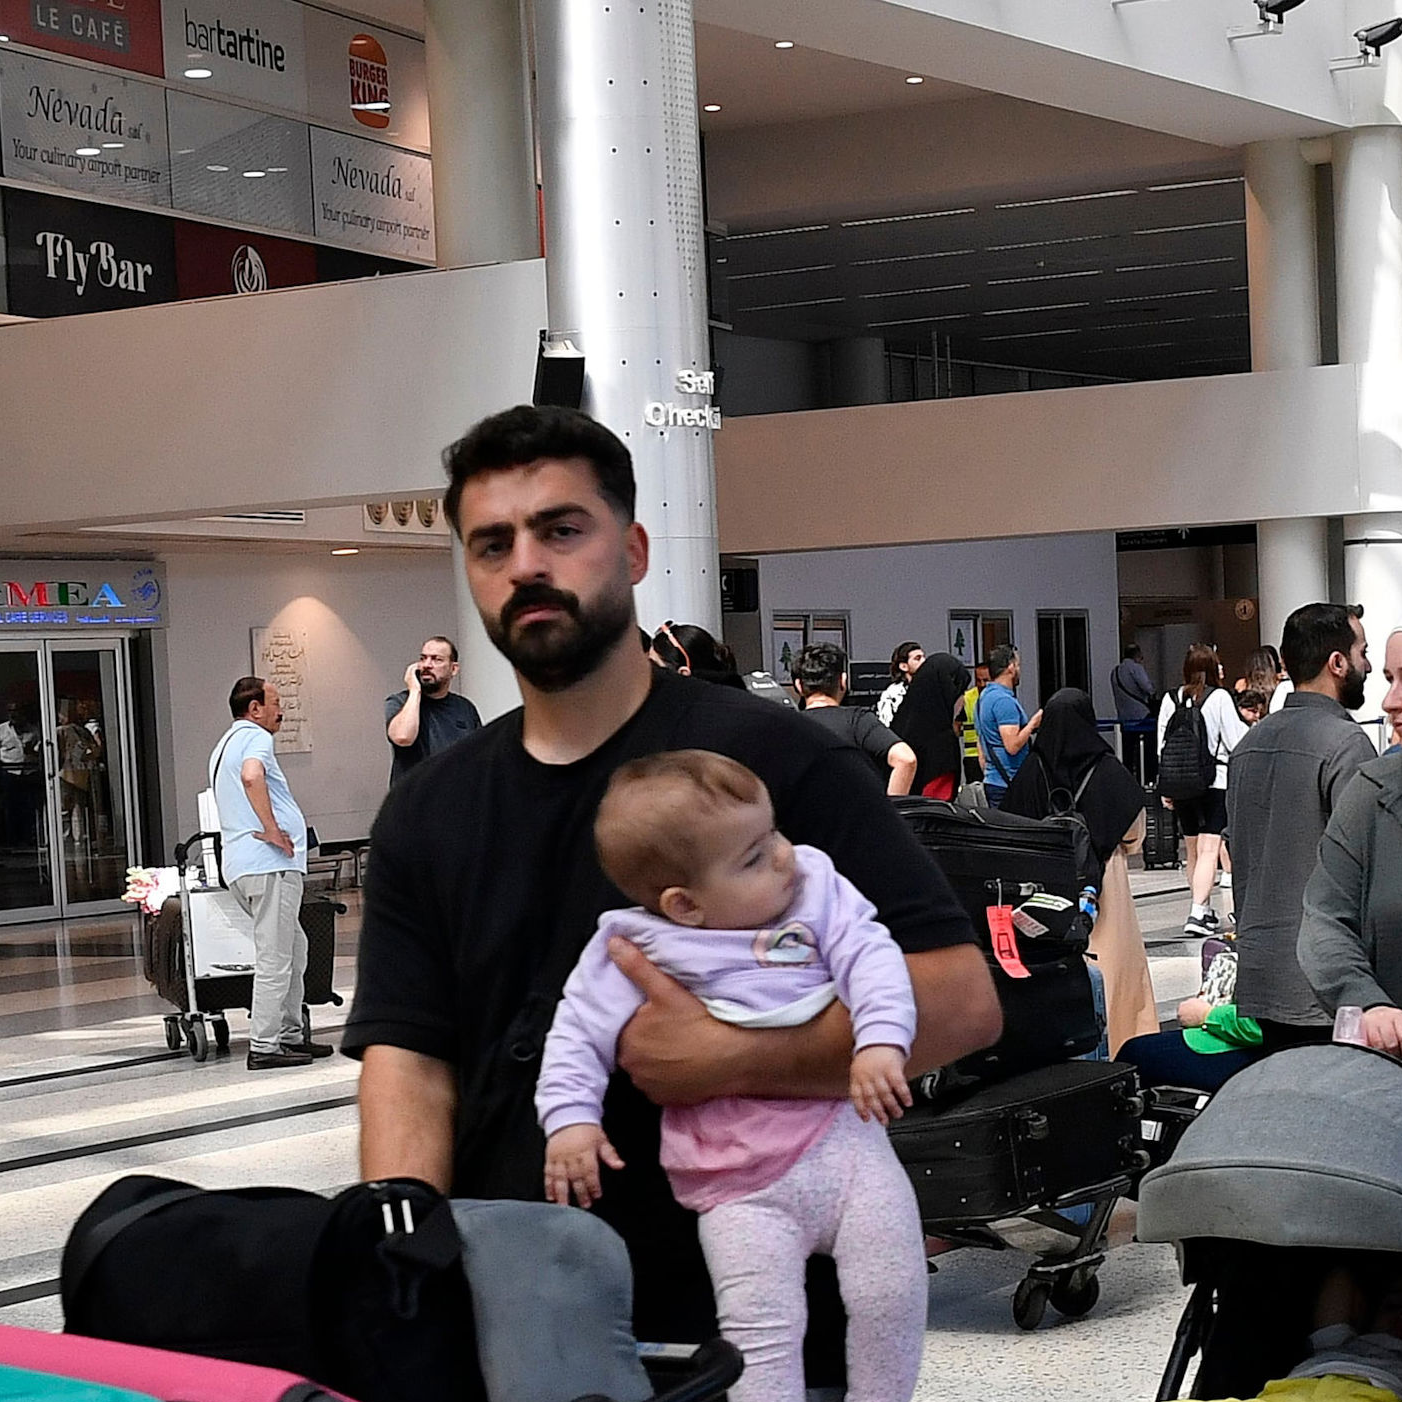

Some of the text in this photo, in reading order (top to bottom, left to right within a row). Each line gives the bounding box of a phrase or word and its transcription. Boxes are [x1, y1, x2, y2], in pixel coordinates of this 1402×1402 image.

[35, 4, 124, 46] LE CAFÉ
[183, 8, 286, 72] bartartine
[349, 58, 389, 87] BURGER
[27, 86, 124, 137] Nevada
[350, 79, 389, 113] KING
[12, 138, 38, 161] Your
[331, 157, 403, 200] Nevada
[36, 231, 153, 297] Fly Bar
[2, 581, 126, 608] MEA
